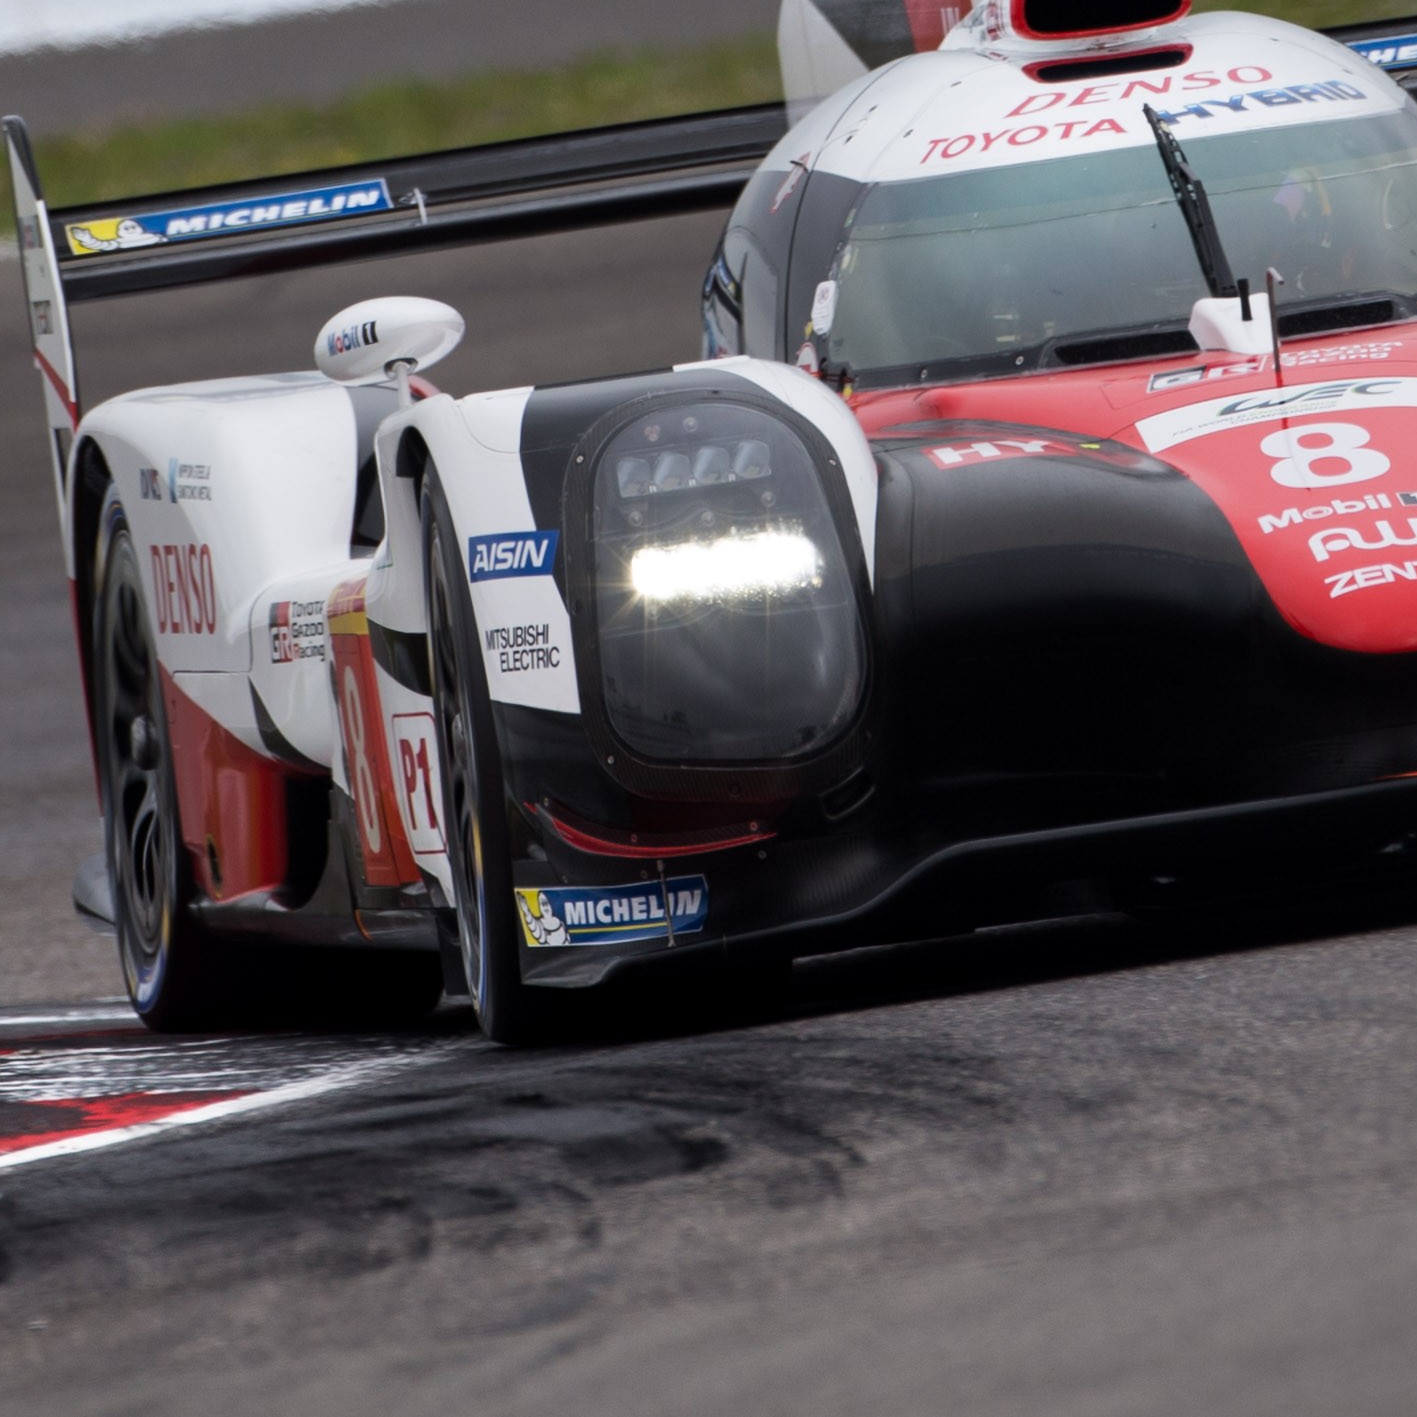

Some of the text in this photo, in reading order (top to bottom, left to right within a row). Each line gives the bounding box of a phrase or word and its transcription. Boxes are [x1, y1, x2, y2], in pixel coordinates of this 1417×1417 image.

[1005, 66, 1273, 118] DENSO
[920, 79, 1368, 164] TOYOTA HYBRID
[166, 190, 380, 235] MICHELIN
[328, 322, 376, 356] Mobil 1
[1217, 381, 1403, 417] WEC
[932, 440, 1051, 465] HY
[1260, 422, 1391, 489] 8
[1257, 493, 1392, 535] Mobil
[473, 539, 549, 574] AISIN
[149, 543, 216, 634] DENSO
[292, 600, 325, 619] TOYOTA
[270, 626, 293, 661] GR
[292, 622, 325, 639] GAZOO
[485, 623, 550, 651] MITSUBISHI
[293, 643, 326, 662] Racing
[499, 646, 561, 673] ELECTRIC
[344, 665, 382, 854] 8
[399, 737, 439, 831] P1
[564, 889, 702, 926] MICHELIN
